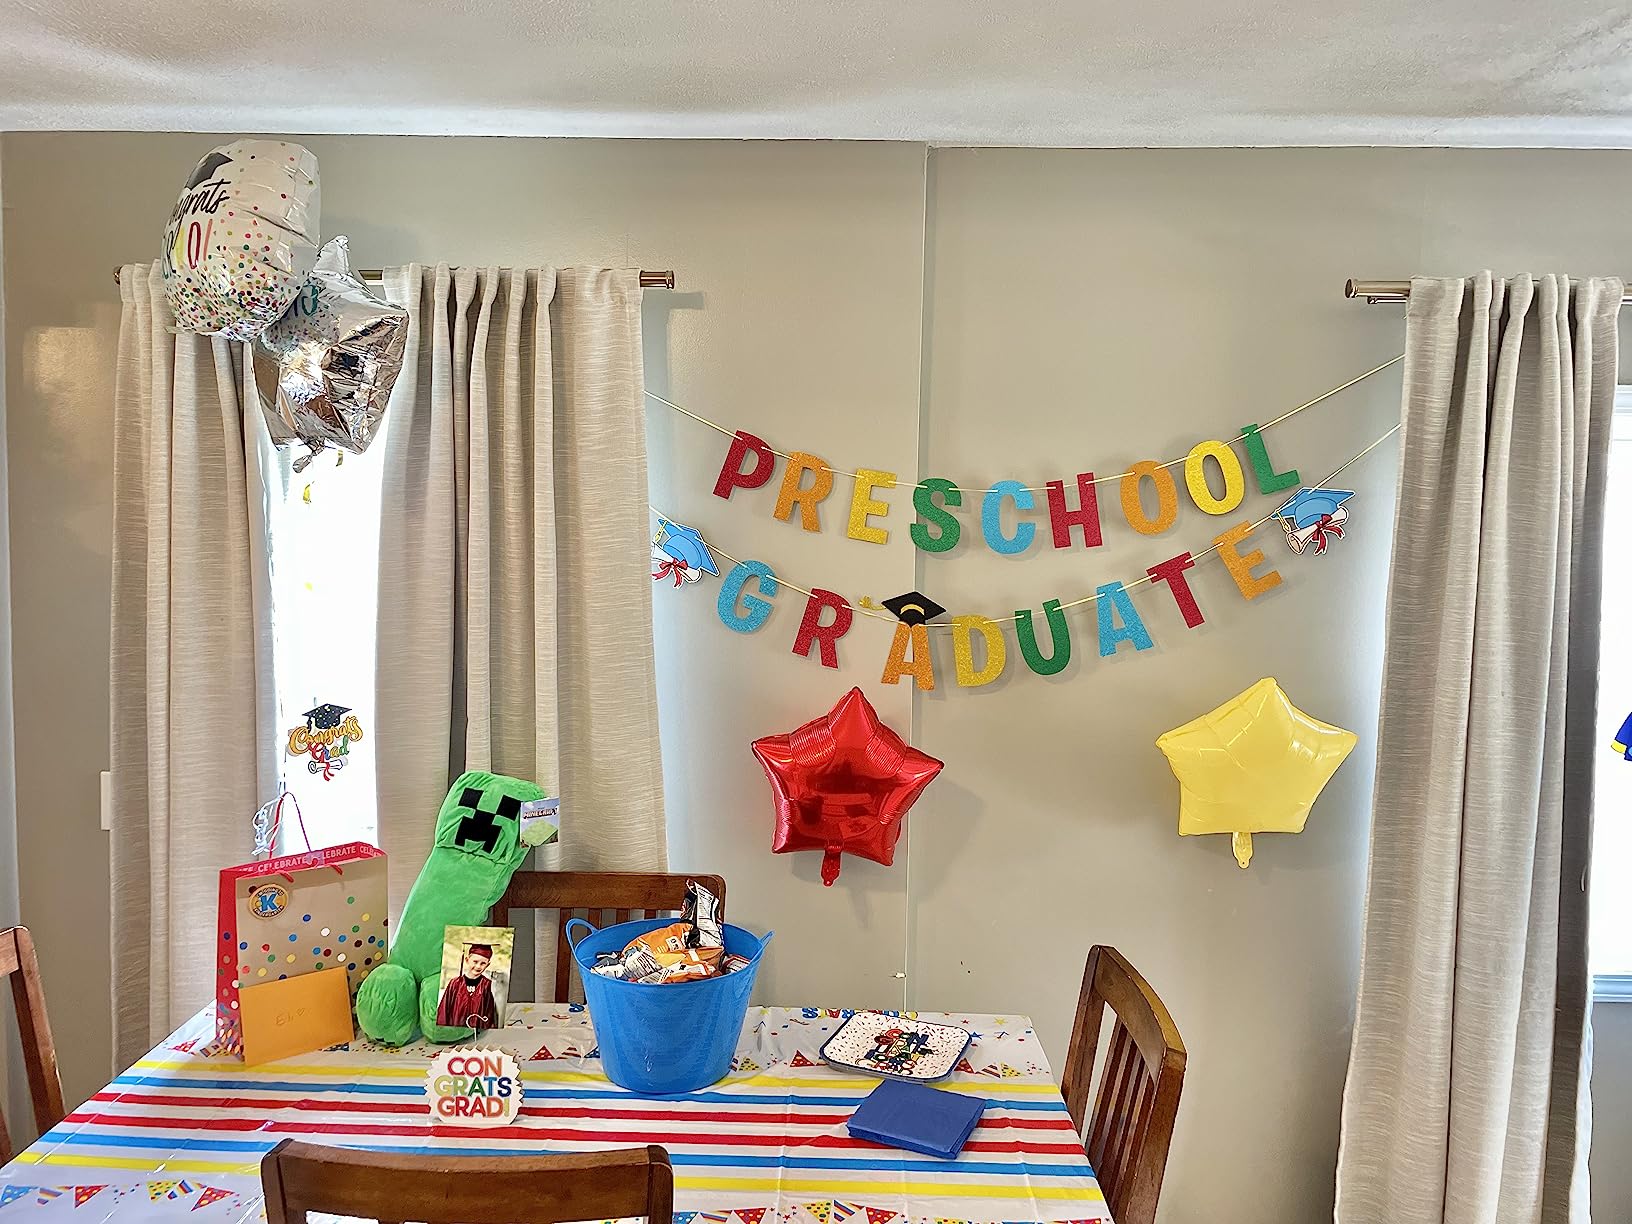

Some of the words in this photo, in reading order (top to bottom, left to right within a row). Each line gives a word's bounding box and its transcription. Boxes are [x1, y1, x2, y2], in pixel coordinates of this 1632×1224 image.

[713, 423, 1300, 555] PRESCHOOL
[717, 519, 1284, 692] GRADUATE
[289, 715, 363, 755] Congrats
[260, 893, 278, 912] K
[447, 1056, 503, 1078] CON
[433, 1074, 512, 1098] GRATS
